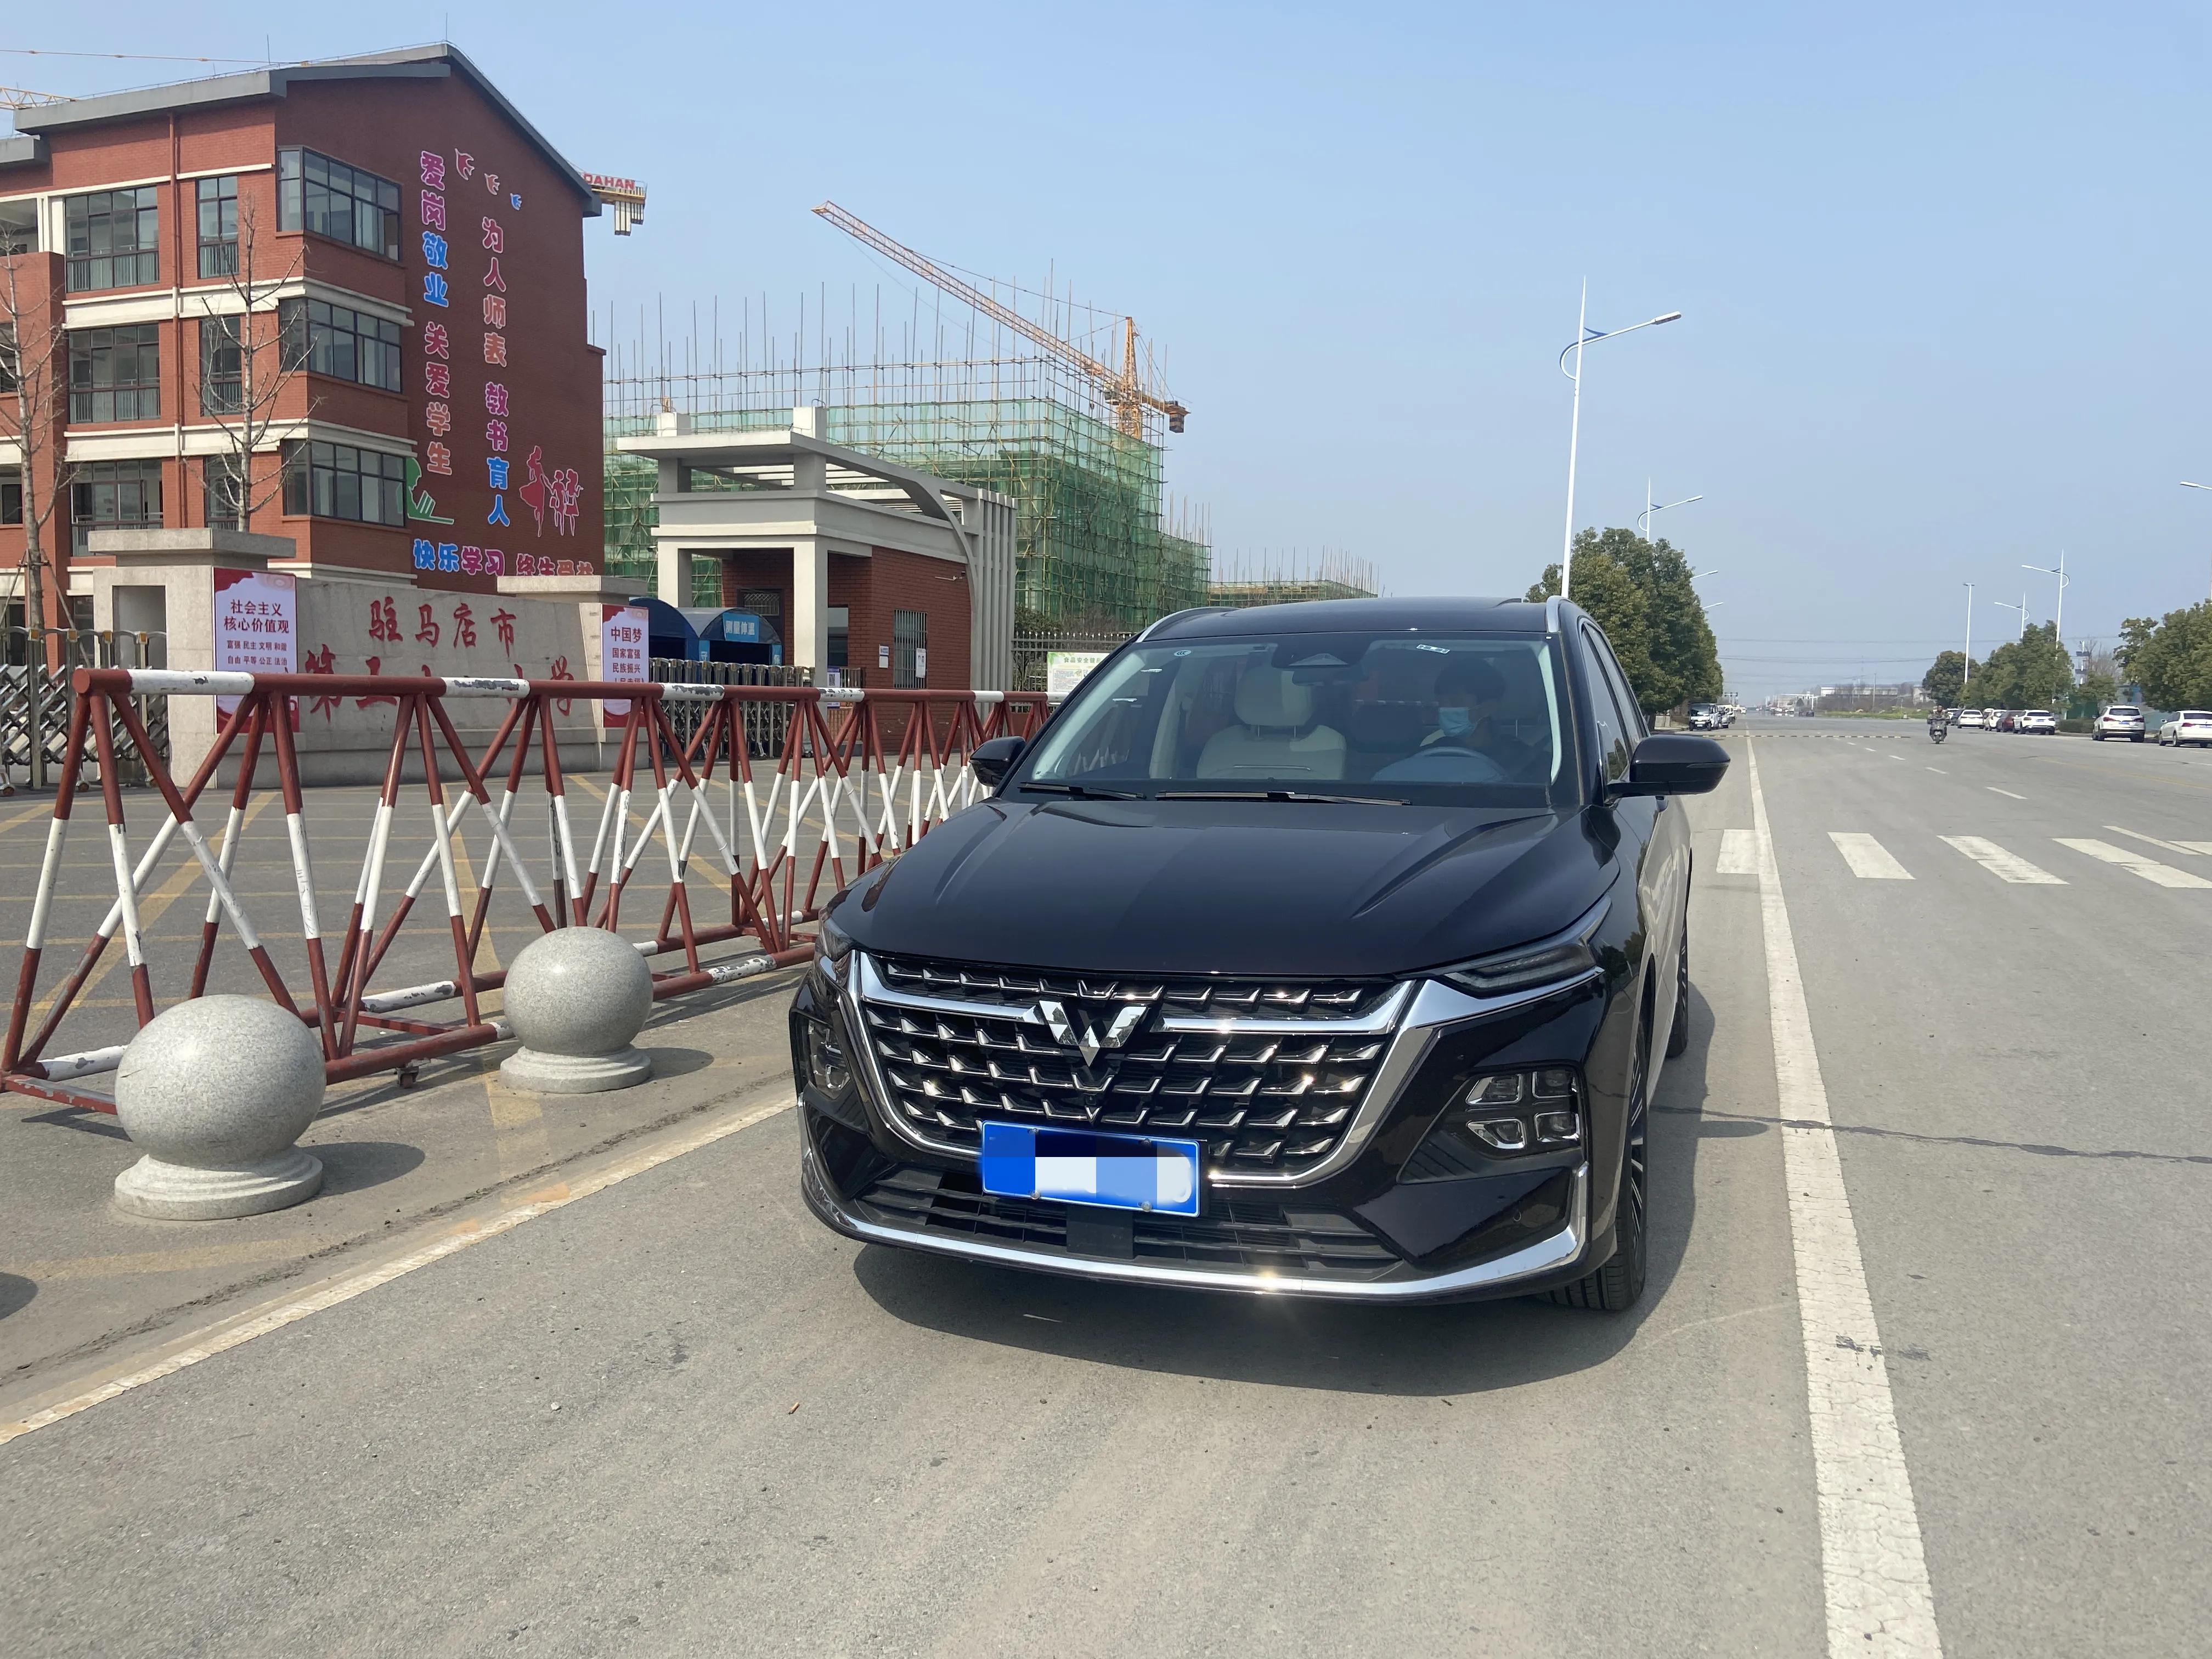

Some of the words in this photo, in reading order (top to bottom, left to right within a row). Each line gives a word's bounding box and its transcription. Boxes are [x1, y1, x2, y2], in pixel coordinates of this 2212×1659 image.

[583, 173, 635, 189] DAHAN
[420, 151, 449, 307] 爱岗敬业
[482, 216, 507, 368] 为人师表
[424, 321, 453, 475] 关爱学生
[485, 382, 510, 527] 教书育人
[413, 538, 505, 577] 快乐学习
[230, 599, 282, 616] 社会主义
[224, 616, 289, 633] 核心价值观
[369, 596, 517, 658] 驻马店市
[725, 620, 755, 635] 测量体温
[611, 626, 642, 643] 中国梦
[259, 642, 272, 651] 文明
[612, 648, 641, 659] 国家富强
[259, 657, 272, 665] 公正
[613, 662, 641, 674] 民族振兴
